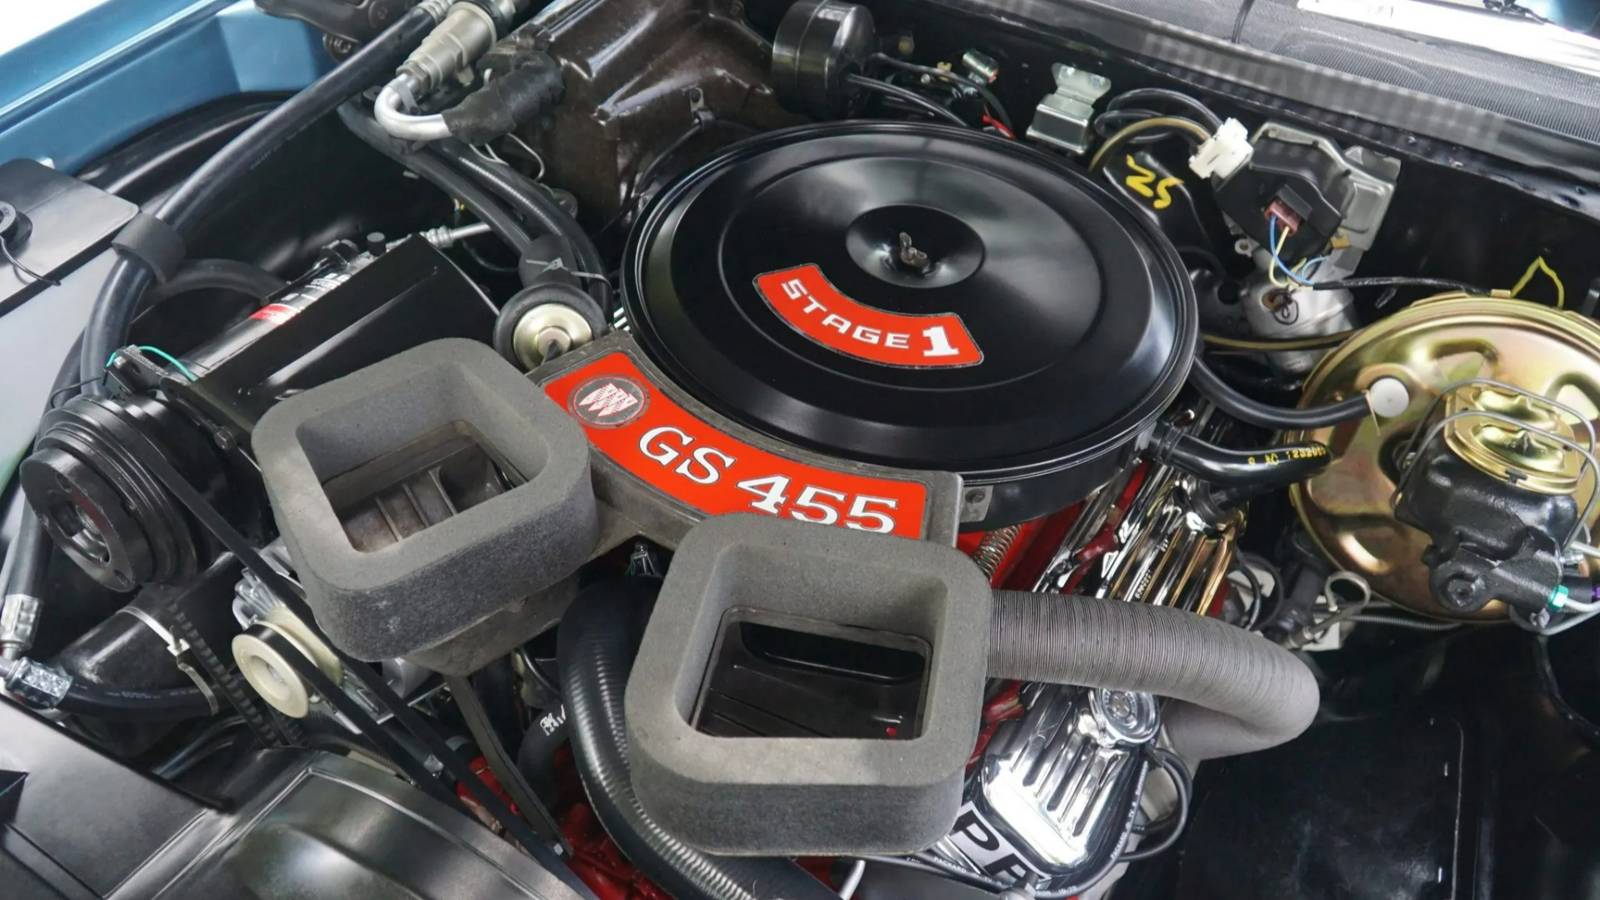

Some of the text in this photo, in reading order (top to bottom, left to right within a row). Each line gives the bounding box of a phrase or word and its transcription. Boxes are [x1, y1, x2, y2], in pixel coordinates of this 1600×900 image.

[781, 278, 960, 358] STAGE 1
[638, 425, 900, 534] GS 455
